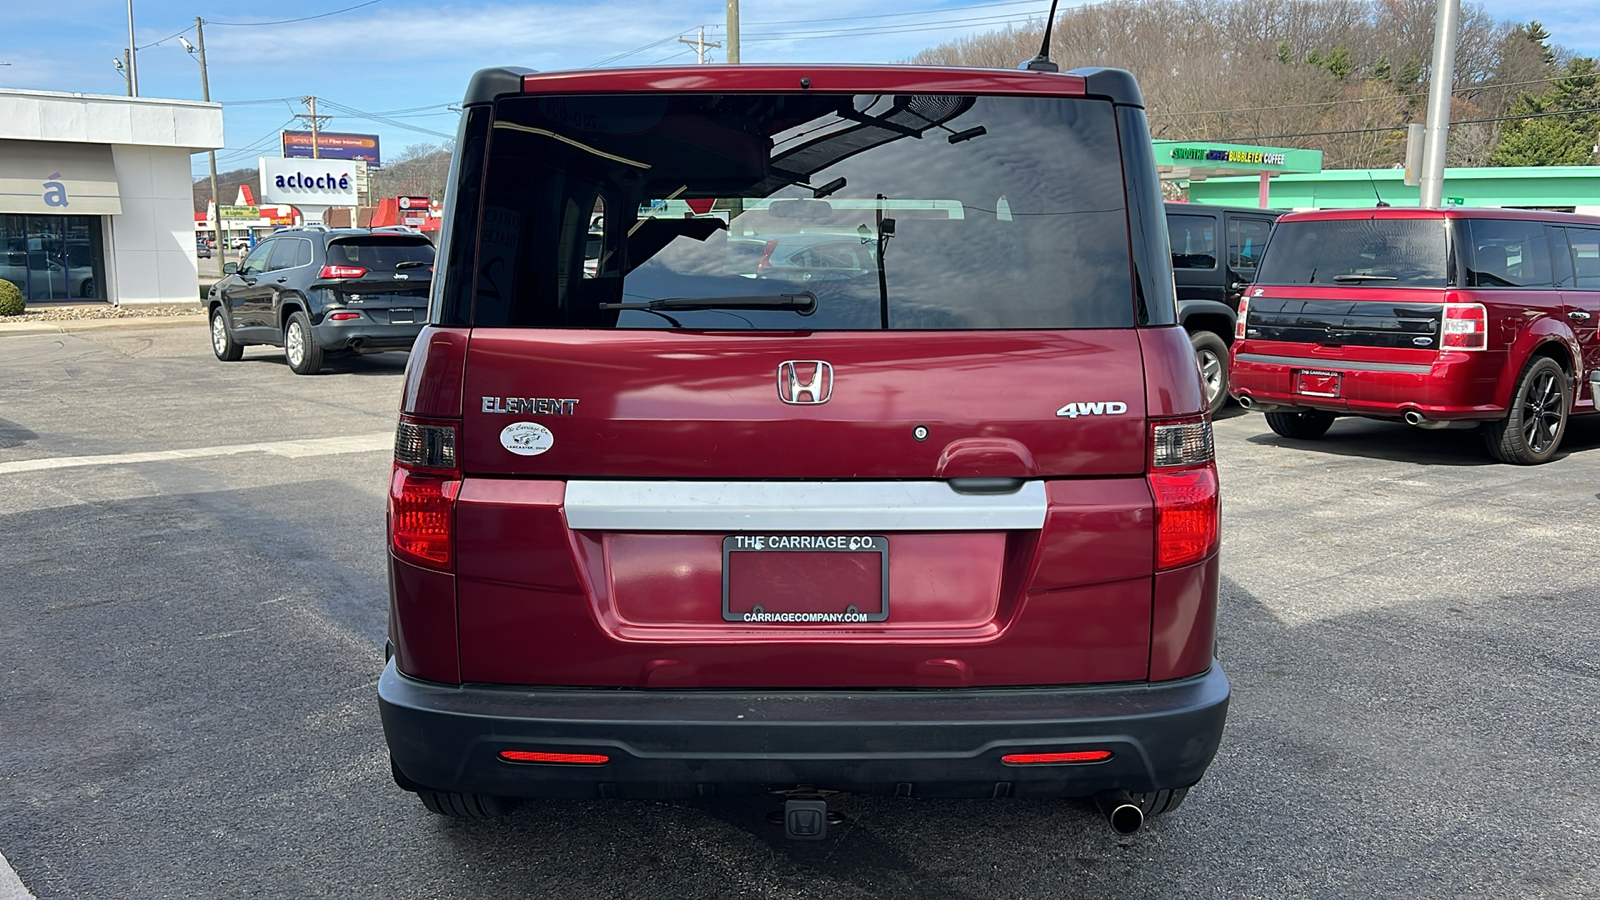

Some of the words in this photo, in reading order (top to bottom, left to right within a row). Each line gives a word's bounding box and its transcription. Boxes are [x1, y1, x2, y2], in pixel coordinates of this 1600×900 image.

[1263, 153, 1285, 164] COFFEE
[275, 172, 348, 189] acloché
[43, 172, 69, 207] á
[481, 396, 579, 415] ELEMENT
[1056, 402, 1127, 418] 4WD
[735, 536, 765, 548] THE
[769, 536, 847, 548] CARRIAGE
[850, 536, 876, 548] CO.
[743, 613, 868, 622] CARRIAGECOMPANY.COM
